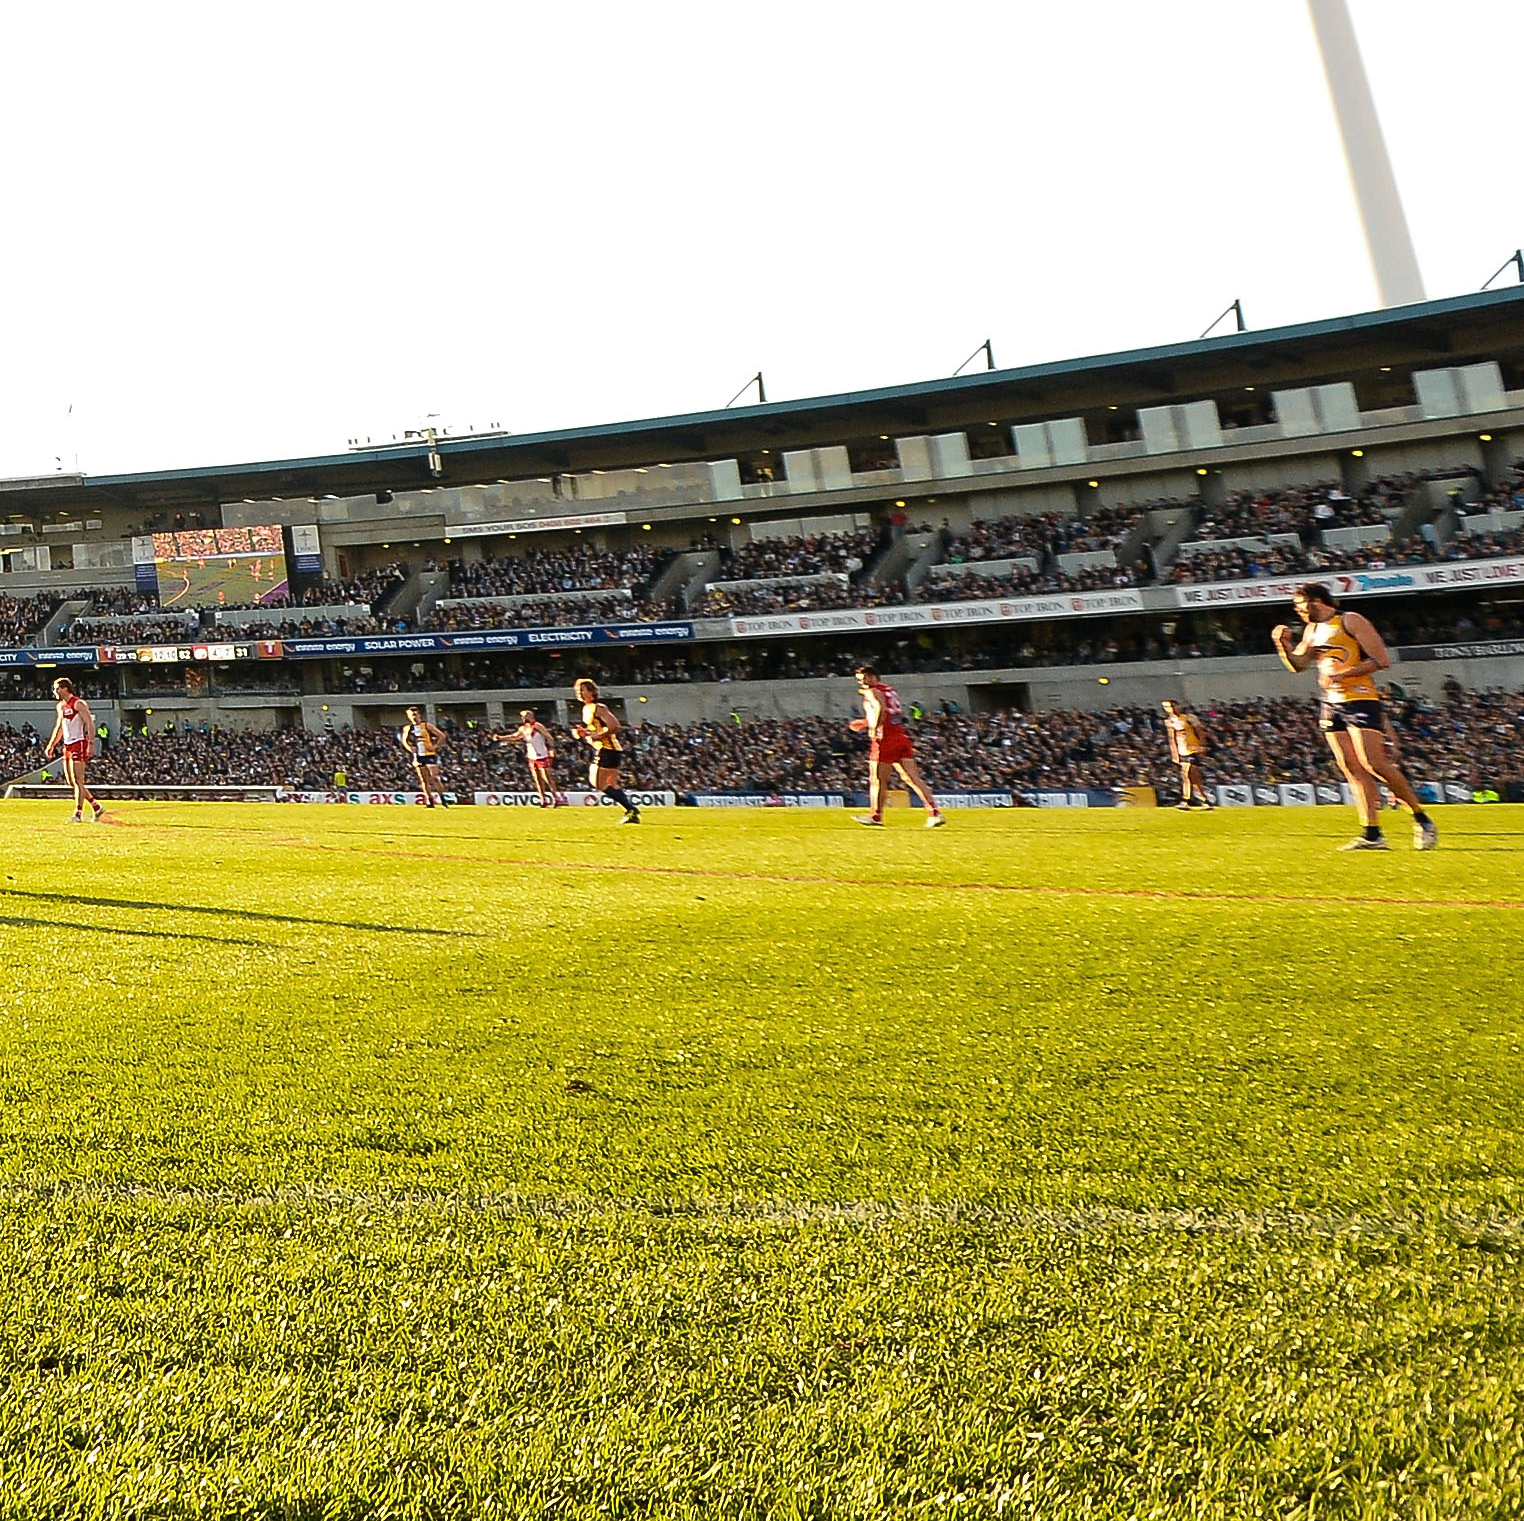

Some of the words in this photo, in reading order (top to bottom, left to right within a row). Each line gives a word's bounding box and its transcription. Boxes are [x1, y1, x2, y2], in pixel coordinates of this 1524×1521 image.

[528, 631, 593, 643] ELECTRICITY
[364, 640, 398, 650] SOLAR
[398, 638, 435, 649] POWER
[369, 793, 406, 805] axs
